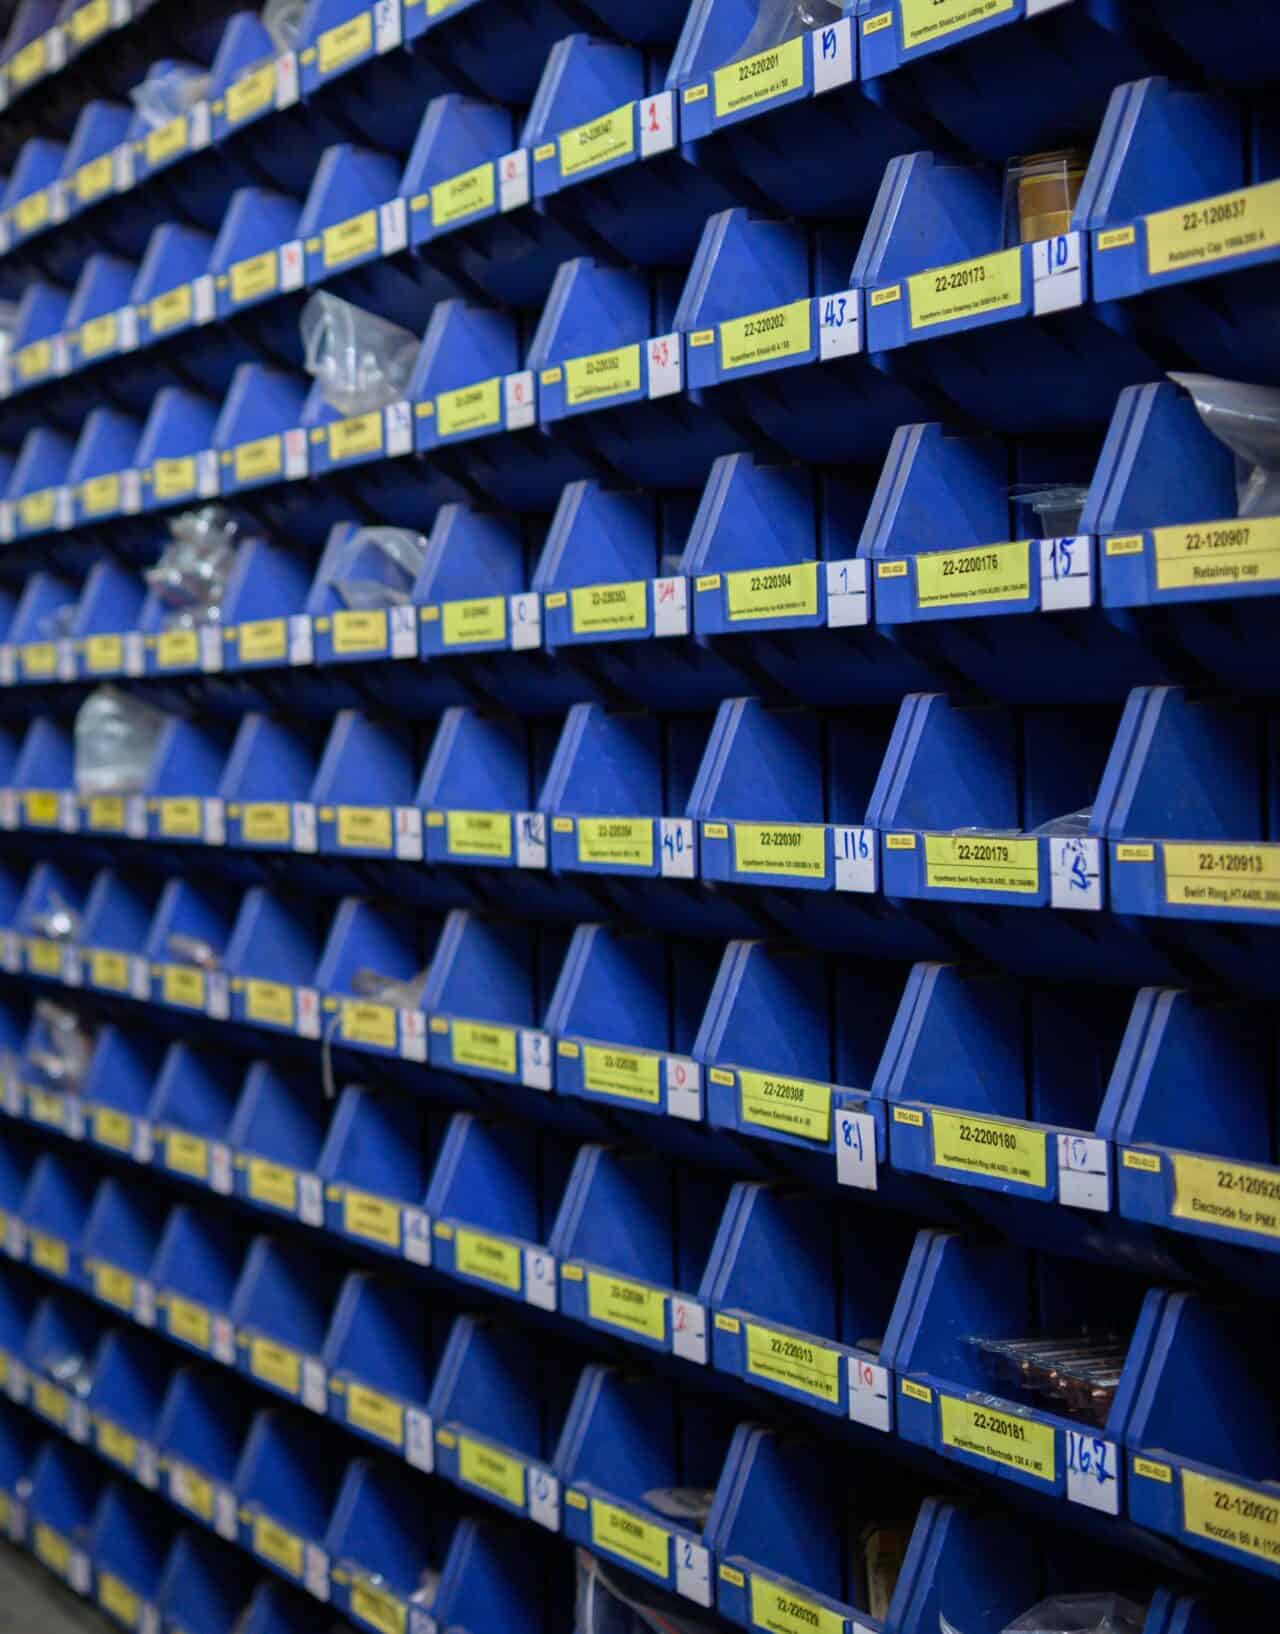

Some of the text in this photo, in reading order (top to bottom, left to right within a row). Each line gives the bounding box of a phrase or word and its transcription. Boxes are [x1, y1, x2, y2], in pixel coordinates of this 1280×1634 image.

[738, 53, 779, 81] 22-220201
[935, 266, 985, 292] 22-220173
[744, 313, 785, 337] 22-220202
[1185, 528, 1250, 551] 22-120907
[942, 553, 999, 576] 22-2200176
[1192, 565, 1239, 579] Retaining
[750, 573, 791, 592] 22-220304
[760, 832, 801, 847] 22-220307
[958, 844, 1009, 862] 22-220179
[1199, 853, 1263, 872] 22-120913
[959, 1125, 1017, 1150] 22-2200180
[1192, 1198, 1276, 1228] Electrode for PMX
[973, 1412, 1025, 1440] 22-220181
[1204, 1522, 1236, 1540] Nozzle
